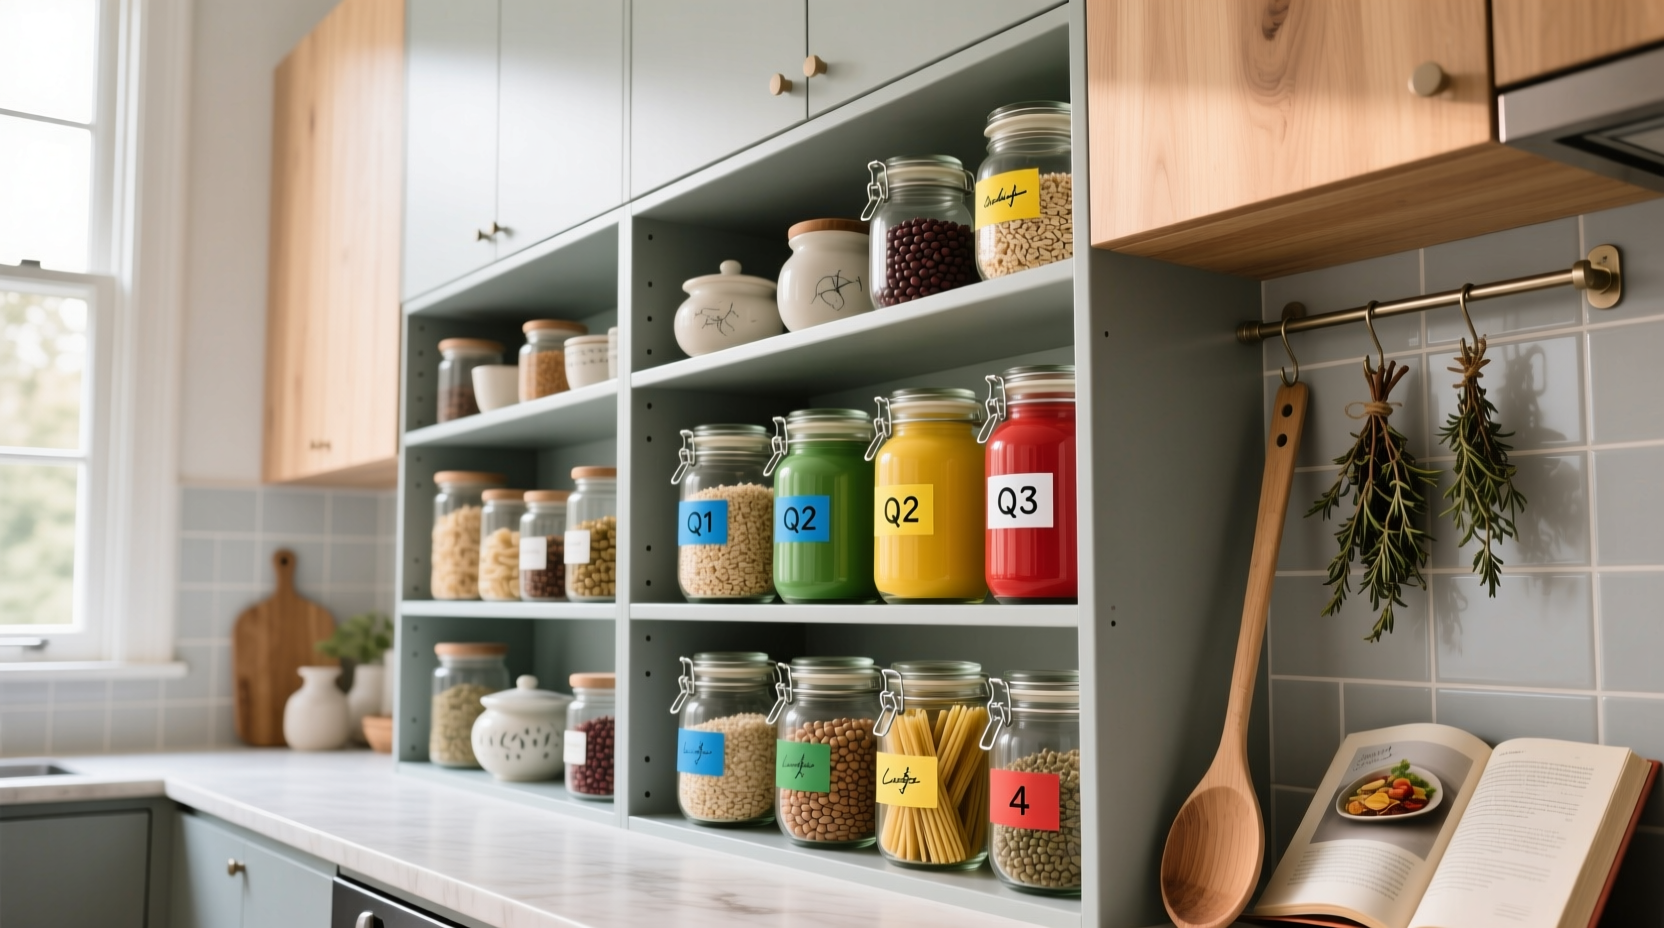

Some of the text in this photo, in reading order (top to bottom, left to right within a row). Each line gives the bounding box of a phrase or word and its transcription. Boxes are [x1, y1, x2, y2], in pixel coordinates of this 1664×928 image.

[884, 495, 920, 528] Q2
[997, 485, 1038, 519] Q3
[687, 510, 713, 535] Q1
[783, 505, 817, 533] Q2
[1009, 785, 1030, 816] 4
